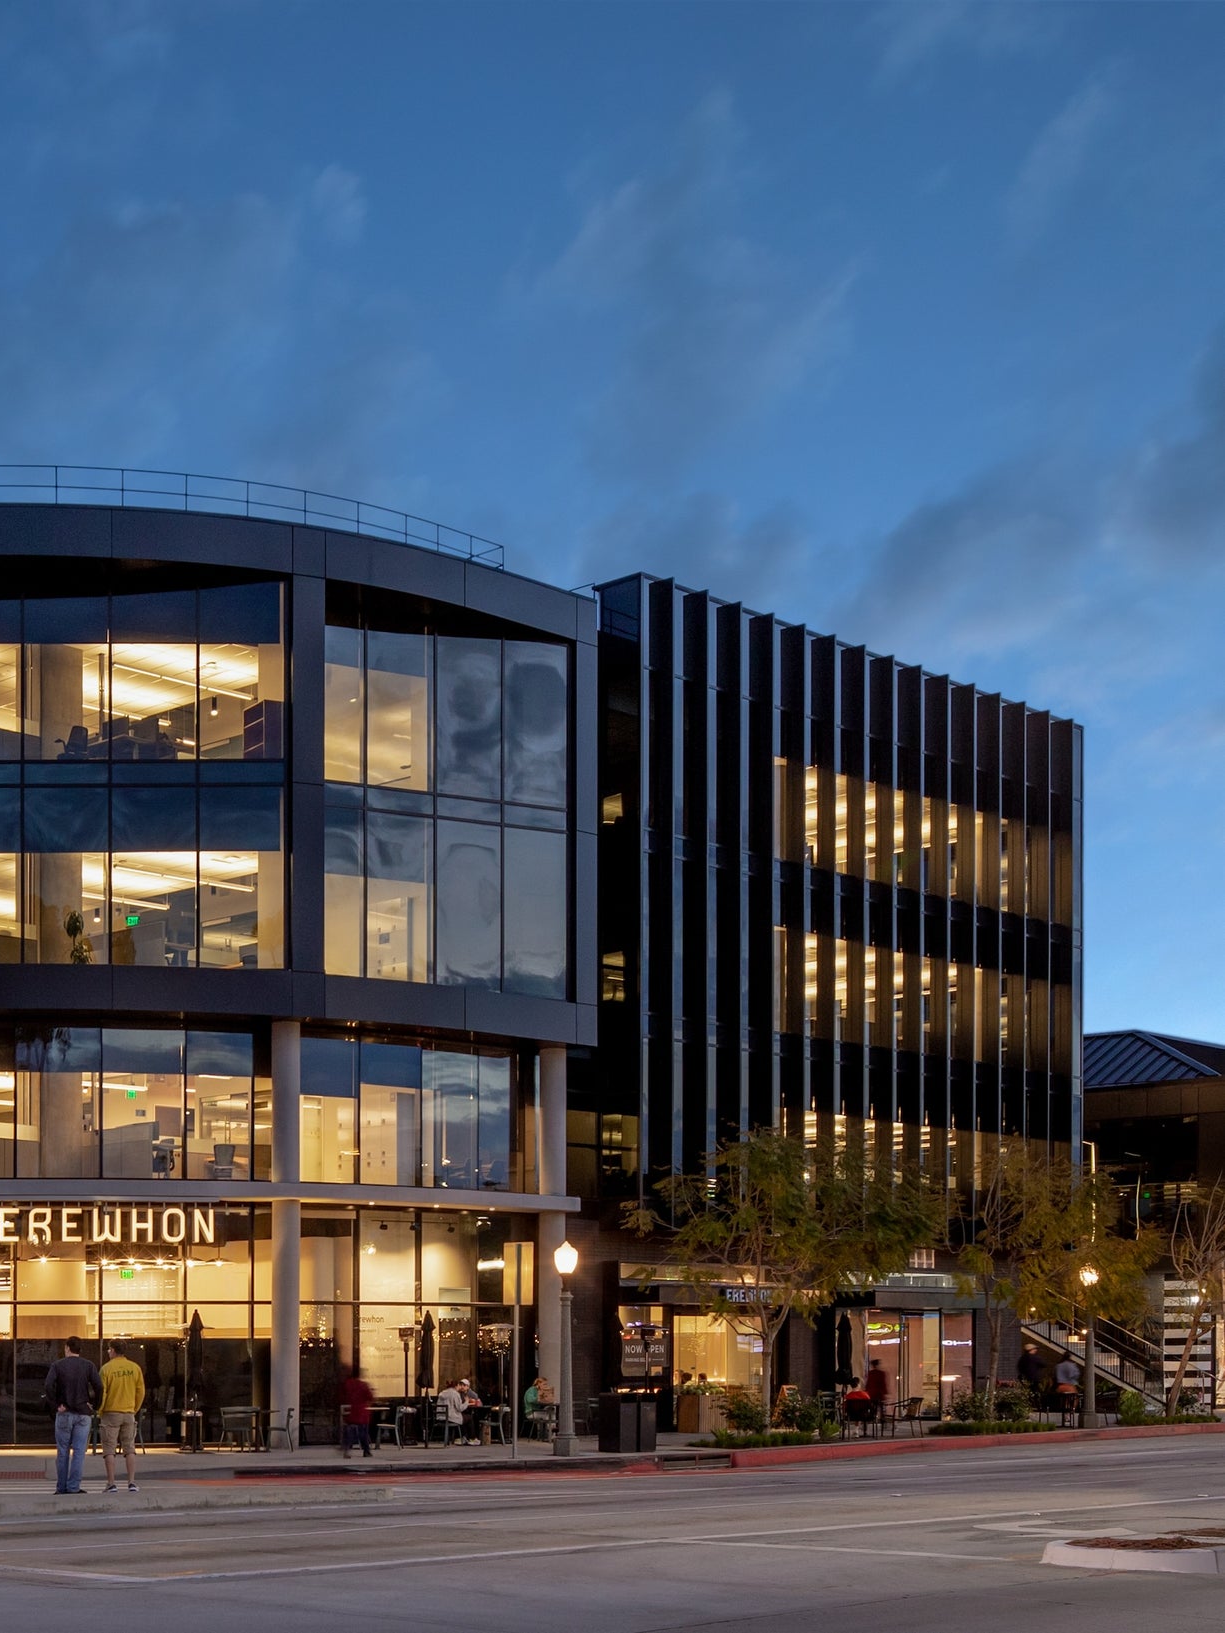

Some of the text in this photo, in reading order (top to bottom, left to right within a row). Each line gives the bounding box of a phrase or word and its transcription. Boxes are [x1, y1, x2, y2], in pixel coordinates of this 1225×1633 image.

[625, 1344, 665, 1354] NOW PEN
[111, 1370, 134, 1378] TEAM
